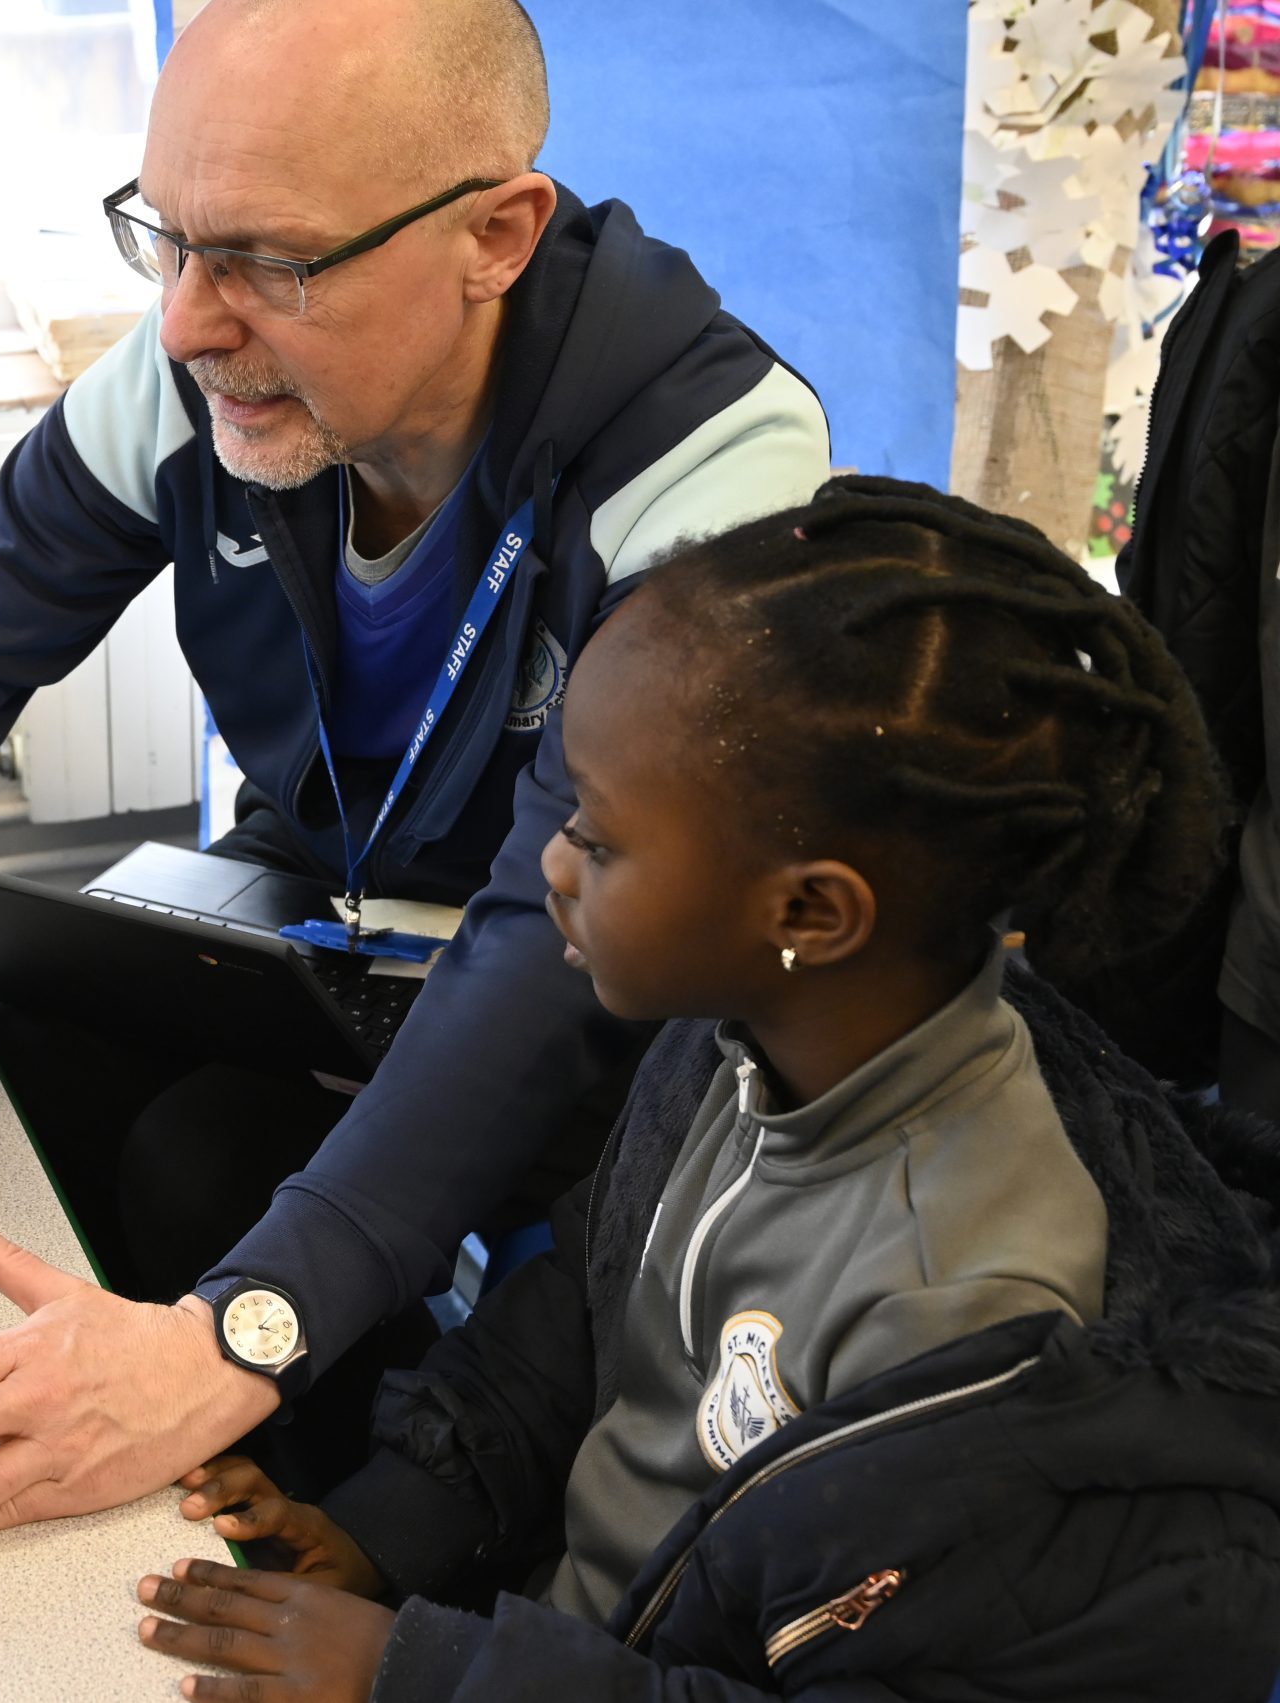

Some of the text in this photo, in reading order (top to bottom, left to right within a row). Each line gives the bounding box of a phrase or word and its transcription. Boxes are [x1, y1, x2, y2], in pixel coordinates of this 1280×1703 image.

[487, 532, 523, 594] STAFF
[446, 622, 477, 681] STAFF
[507, 711, 546, 729] mary
[408, 707, 436, 765] STAFF
[231, 1313, 240, 1322] 5
[230, 1327, 237, 1335] 4
[272, 1344, 283, 1354] 12
[727, 1335, 742, 1355] ST.
[707, 1418, 734, 1466] PRIMA
